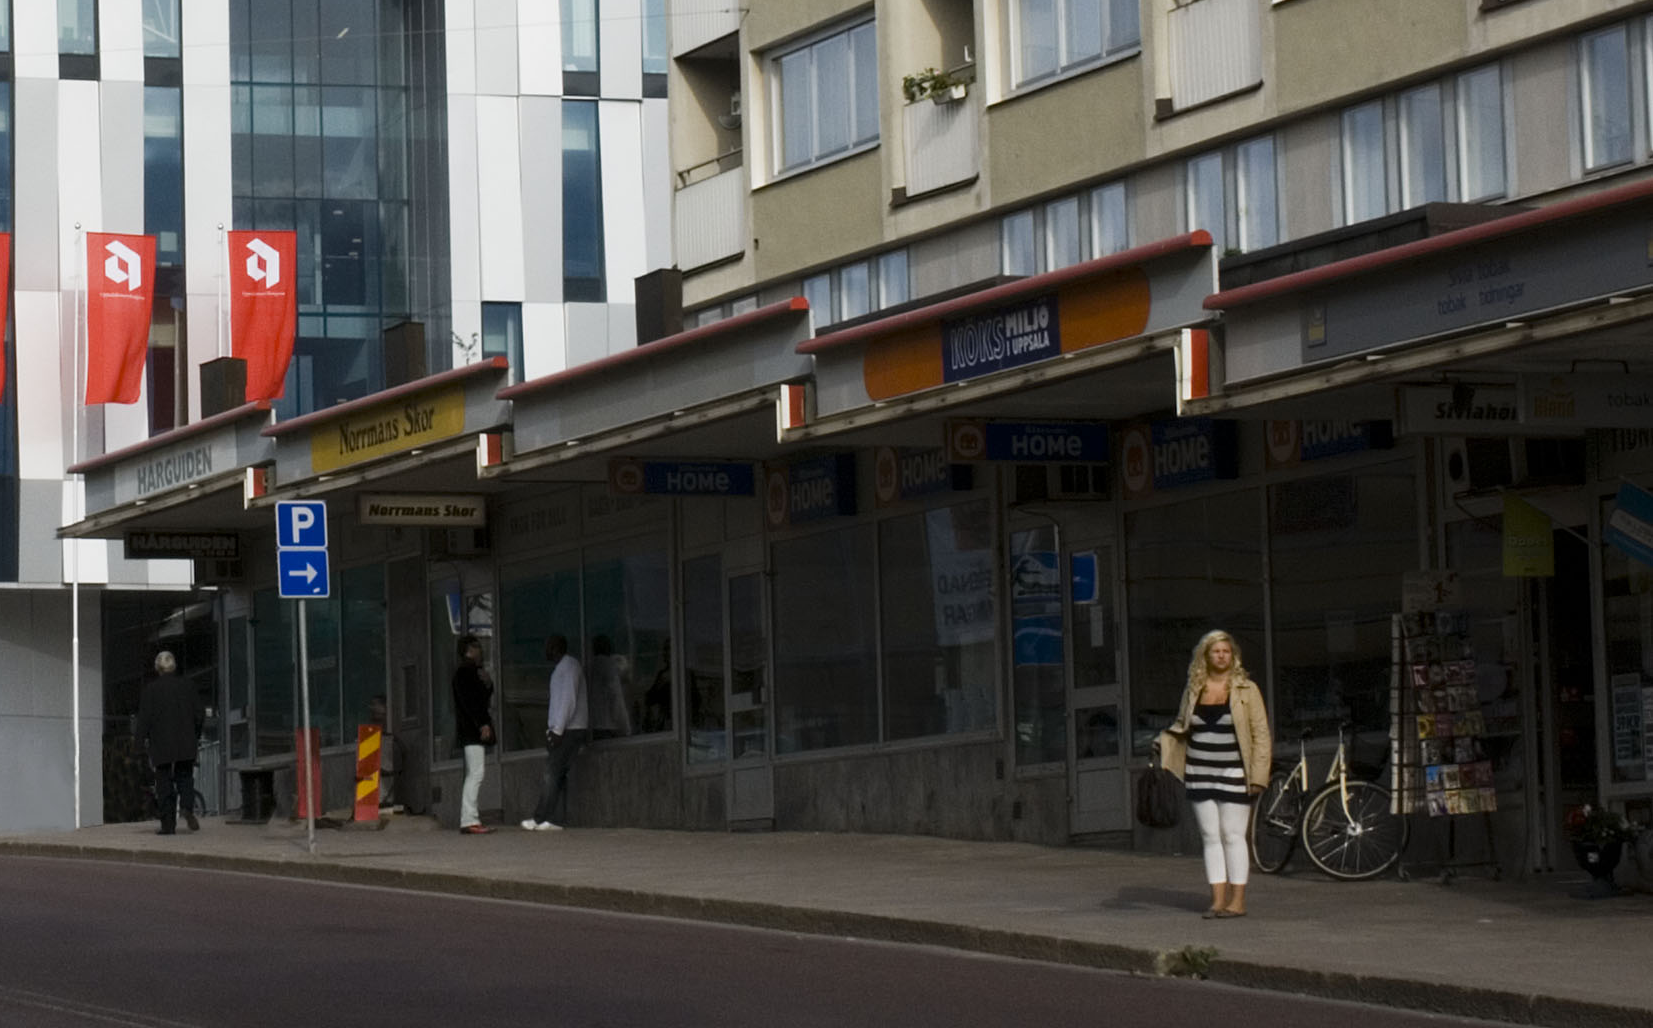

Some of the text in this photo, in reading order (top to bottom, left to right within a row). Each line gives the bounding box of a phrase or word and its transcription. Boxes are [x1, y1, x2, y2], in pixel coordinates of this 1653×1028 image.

[1011, 329, 1051, 356] UPPSALA
[339, 403, 435, 455] Norrmans Skor
[291, 506, 315, 544] P
[368, 503, 477, 518] Norrmans Skor
